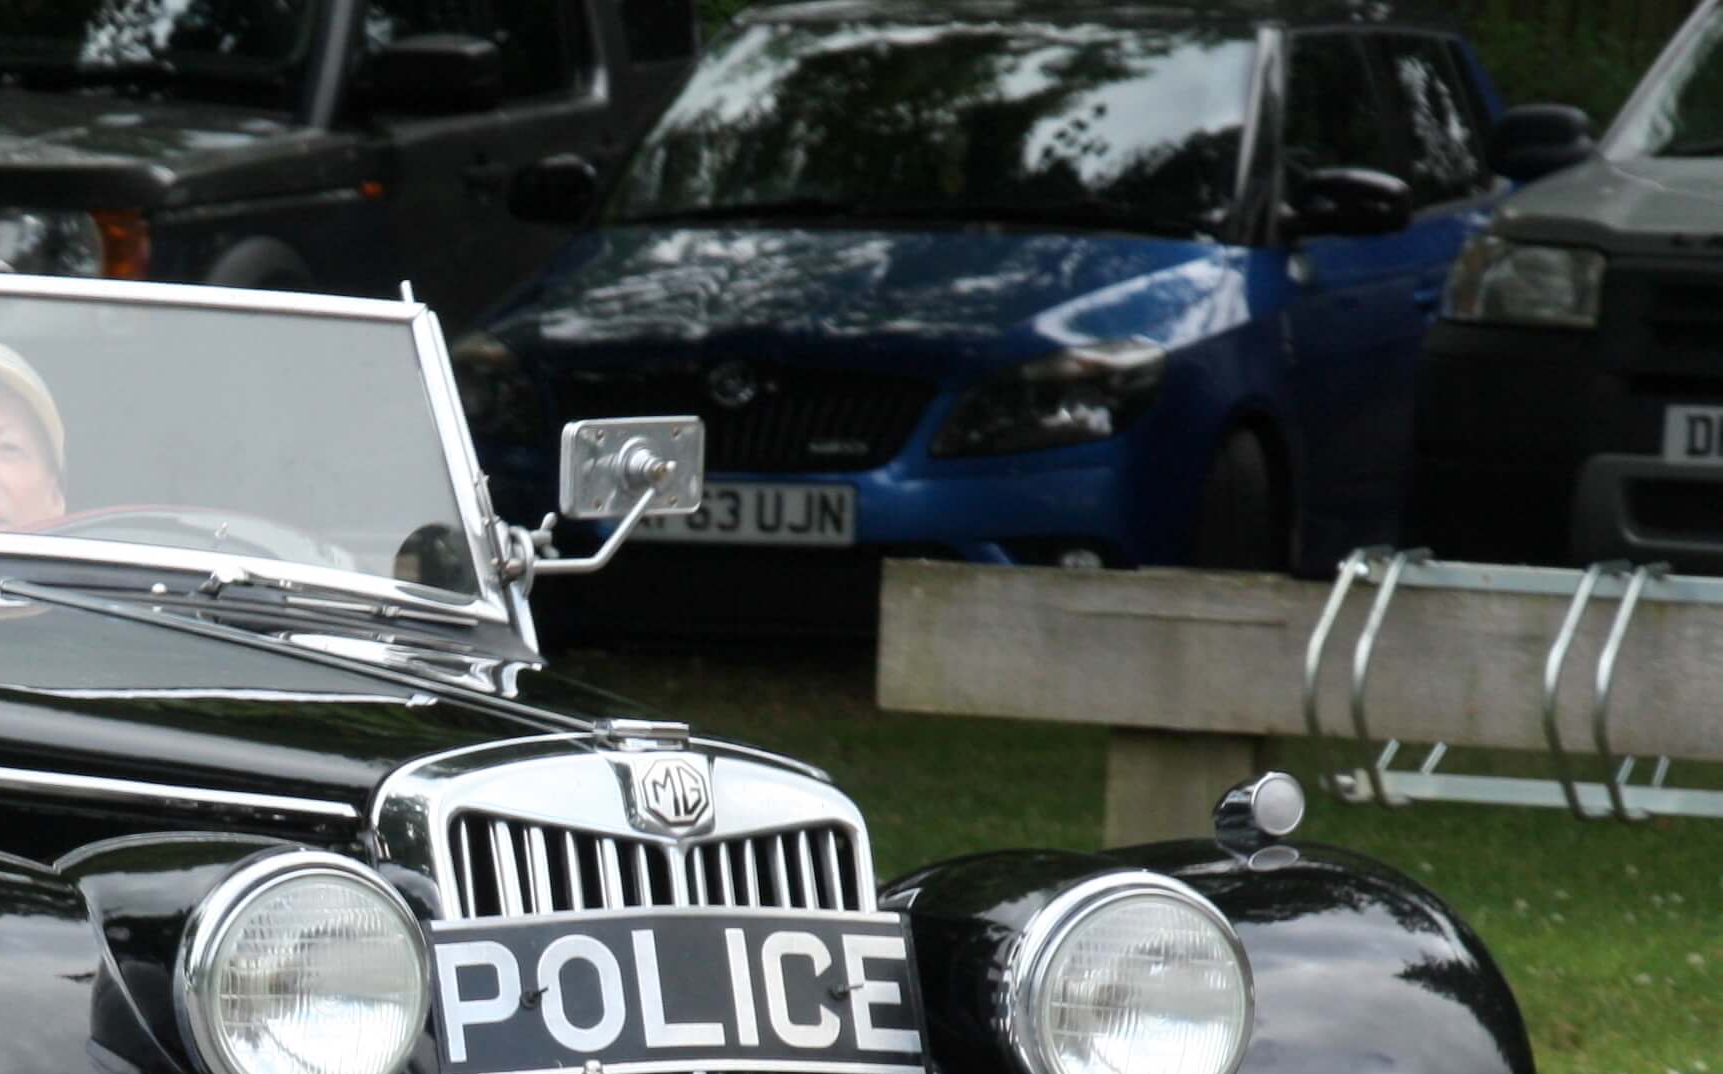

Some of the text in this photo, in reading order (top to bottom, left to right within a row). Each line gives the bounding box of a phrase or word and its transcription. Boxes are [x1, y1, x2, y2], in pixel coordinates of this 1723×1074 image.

[1686, 413, 1723, 457] D
[756, 491, 846, 534] UJN
[651, 765, 703, 817] MG
[434, 928, 921, 1063] POLICE
